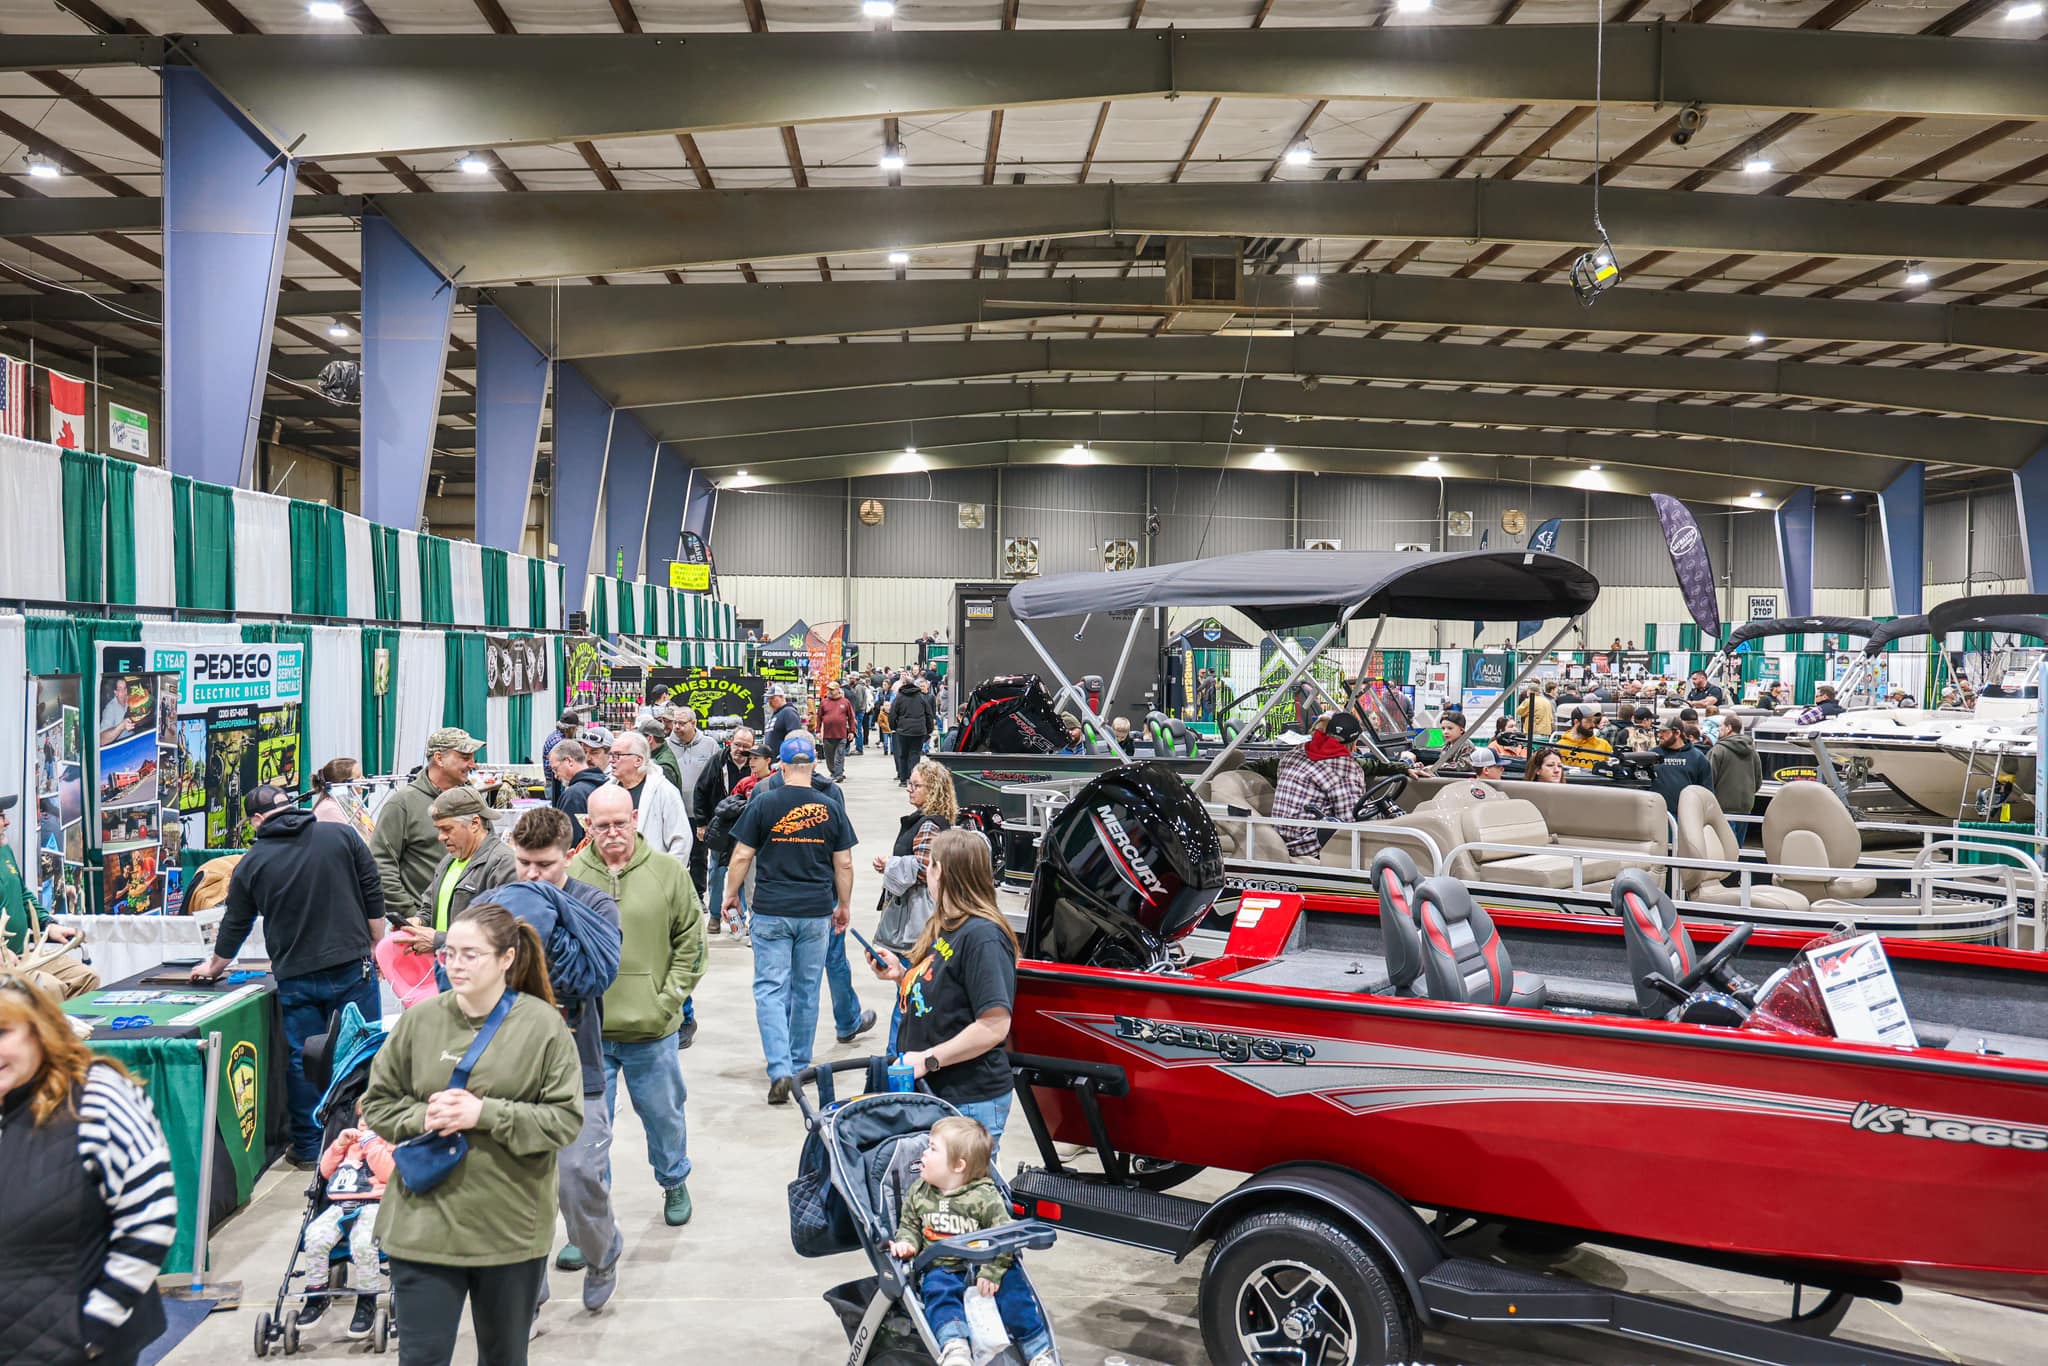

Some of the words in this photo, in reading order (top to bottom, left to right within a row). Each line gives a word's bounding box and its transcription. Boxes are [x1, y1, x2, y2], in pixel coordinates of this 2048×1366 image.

[1751, 598, 1774, 607] SNACK
[1753, 607, 1772, 616] STOP
[156, 653, 162, 668] 5
[164, 653, 185, 669] YEAR
[278, 654, 296, 666] SALES
[194, 653, 271, 680] PEDEGO
[1483, 664, 1502, 675] AQUA
[277, 667, 300, 679] SERVICE
[194, 687, 240, 700] ELECTRIC
[244, 685, 269, 697] BIKES
[277, 680, 300, 693] RENTALS
[668, 679, 752, 700] AMESTONE
[1781, 769, 1799, 777] BOAT
[1097, 804, 1169, 895] MERCURY
[1114, 1014, 1315, 1064] Ranger
[939, 1200, 950, 1212] BE
